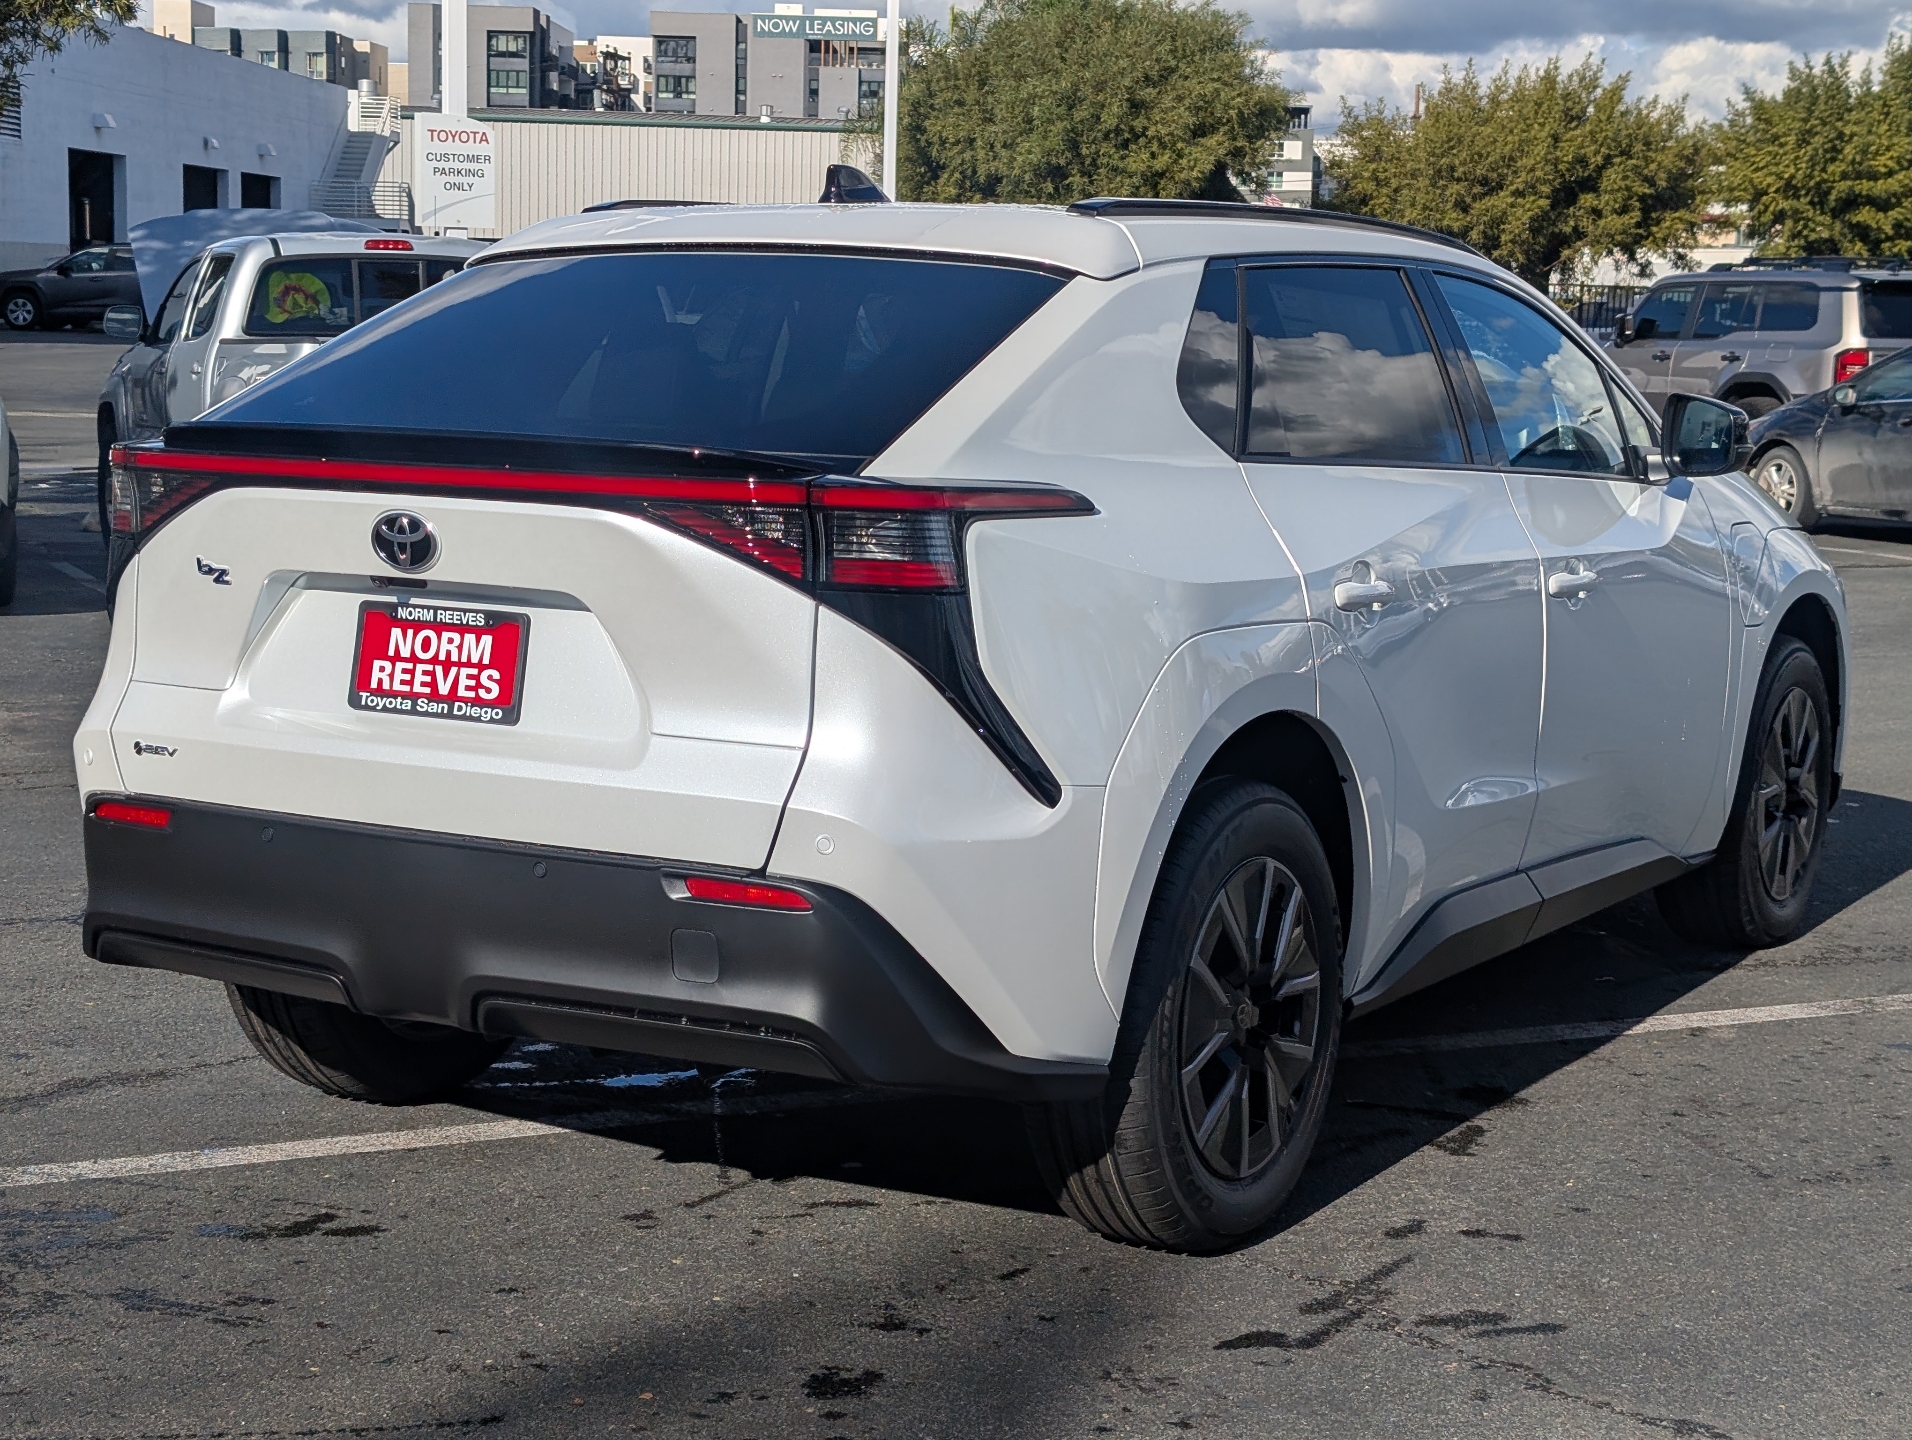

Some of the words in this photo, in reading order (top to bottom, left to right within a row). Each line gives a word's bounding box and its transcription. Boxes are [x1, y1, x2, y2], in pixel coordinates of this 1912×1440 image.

[757, 18, 800, 33] NOW
[805, 20, 874, 36] LEASING
[427, 129, 490, 145] TOYOTA
[426, 152, 492, 164] CUSTOMER
[433, 167, 485, 178] PARKING
[443, 181, 474, 192] ONLY
[397, 607, 434, 622] NORM
[436, 611, 485, 626] REEVES
[387, 627, 493, 665] NORM
[369, 659, 501, 700] REEVES
[358, 692, 412, 710] Toyota
[416, 697, 448, 714] San
[453, 703, 503, 721] Diego
